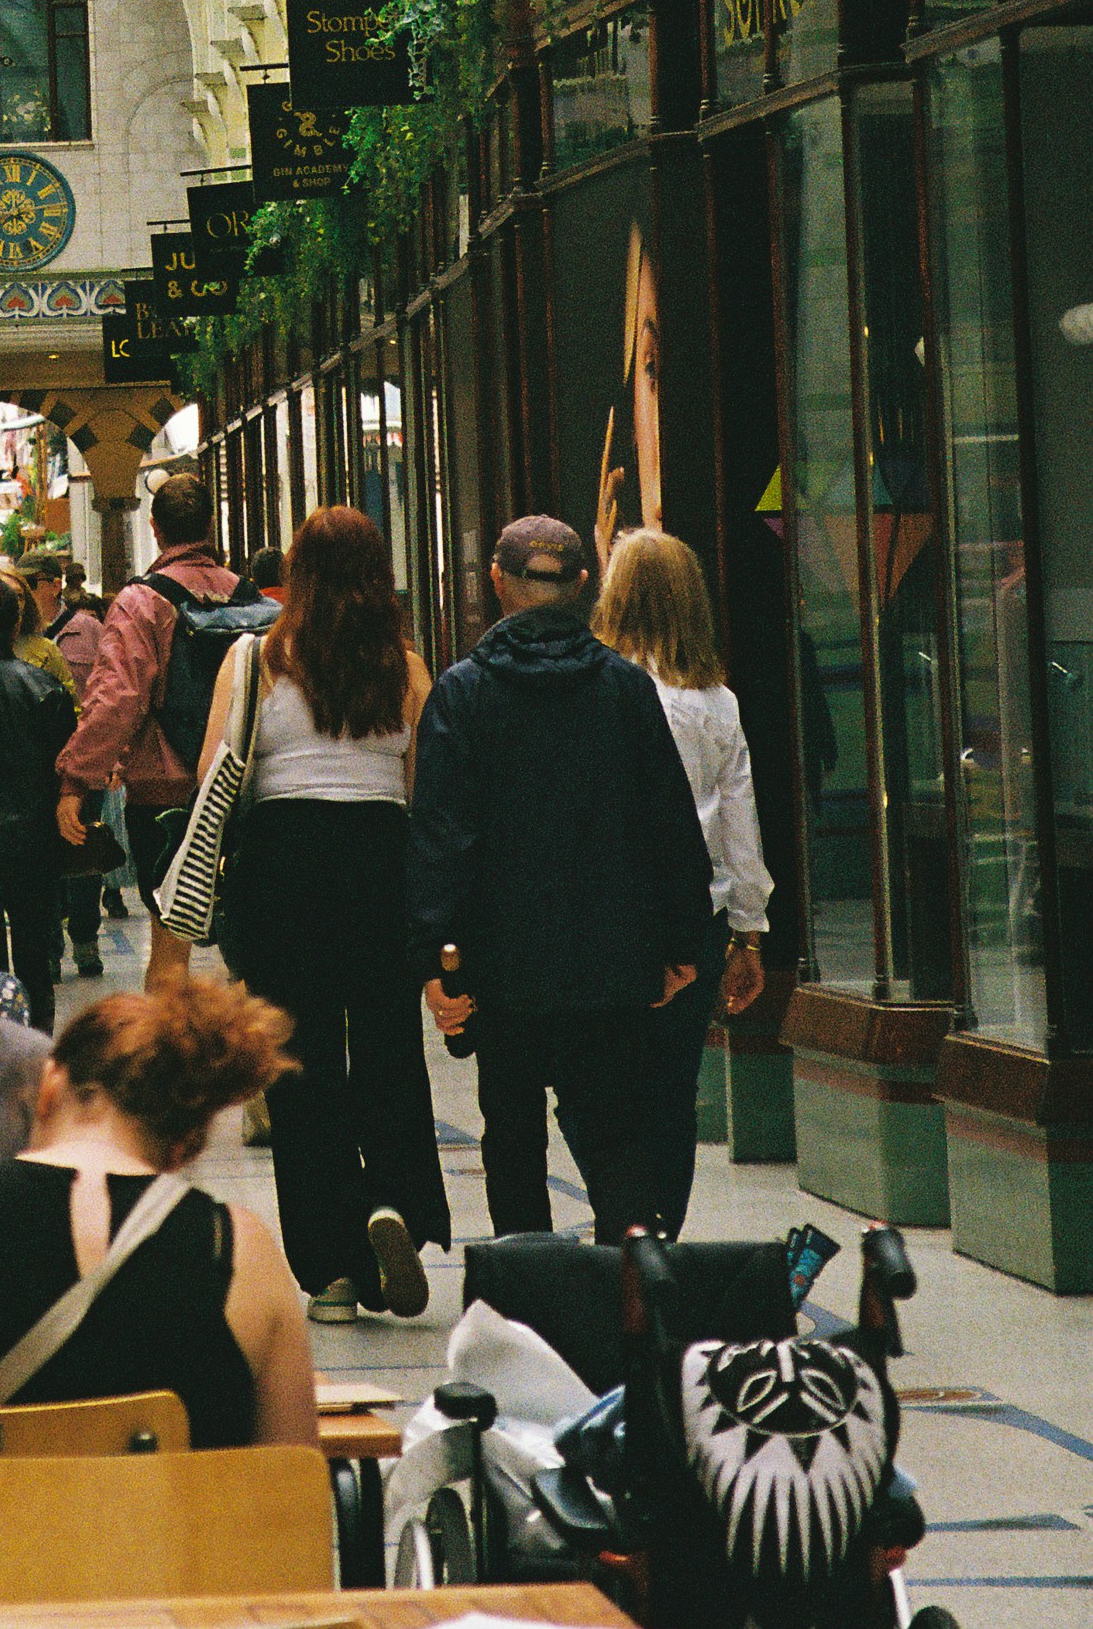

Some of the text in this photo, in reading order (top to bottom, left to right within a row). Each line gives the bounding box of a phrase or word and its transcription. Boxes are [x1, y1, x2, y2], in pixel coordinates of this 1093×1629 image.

[325, 39, 396, 63] Shoes
[276, 126, 341, 158] GIMBLE
[302, 177, 331, 187] SHOP
[168, 280, 184, 298] &
